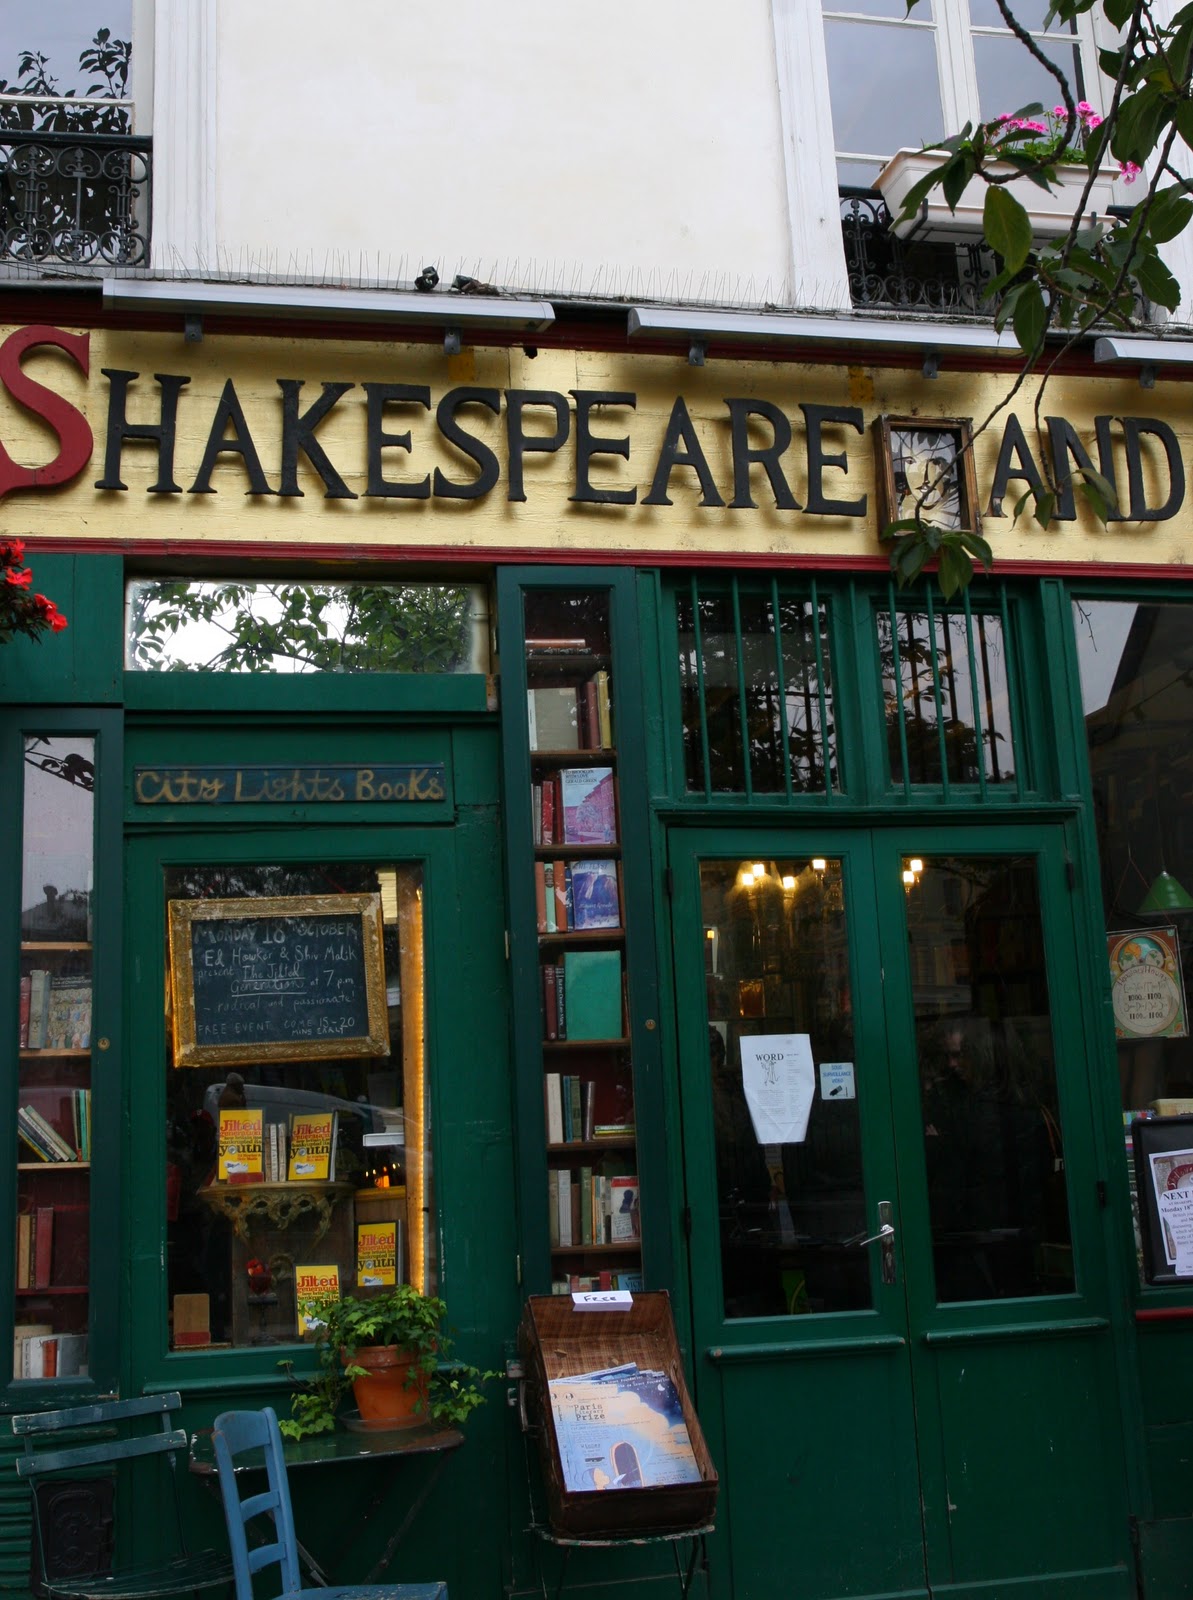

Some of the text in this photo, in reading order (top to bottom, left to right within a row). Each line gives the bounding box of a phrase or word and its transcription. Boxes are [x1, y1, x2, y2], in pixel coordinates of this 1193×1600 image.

[0, 324, 1185, 521] SHAKESPEARE AND
[136, 770, 224, 803] City
[234, 769, 345, 801] Lights
[194, 925, 257, 944] MONDAY
[205, 949, 224, 967] Ed
[294, 944, 318, 962] Shiv
[323, 944, 358, 961] Malik
[242, 965, 263, 980] The
[310, 976, 319, 986] at
[323, 969, 334, 987] 7
[198, 1023, 226, 1036] FREE
[235, 1020, 272, 1034] EVENT
[756, 1053, 784, 1061] WORD
[220, 1119, 261, 1132] Jilted
[294, 1122, 330, 1135] Jilted
[1163, 1190, 1189, 1200] NEXT
[358, 1232, 395, 1246] Jilted
[297, 1275, 338, 1287] Jilted
[574, 1403, 603, 1411] Paris
[576, 1413, 605, 1421] Prize
